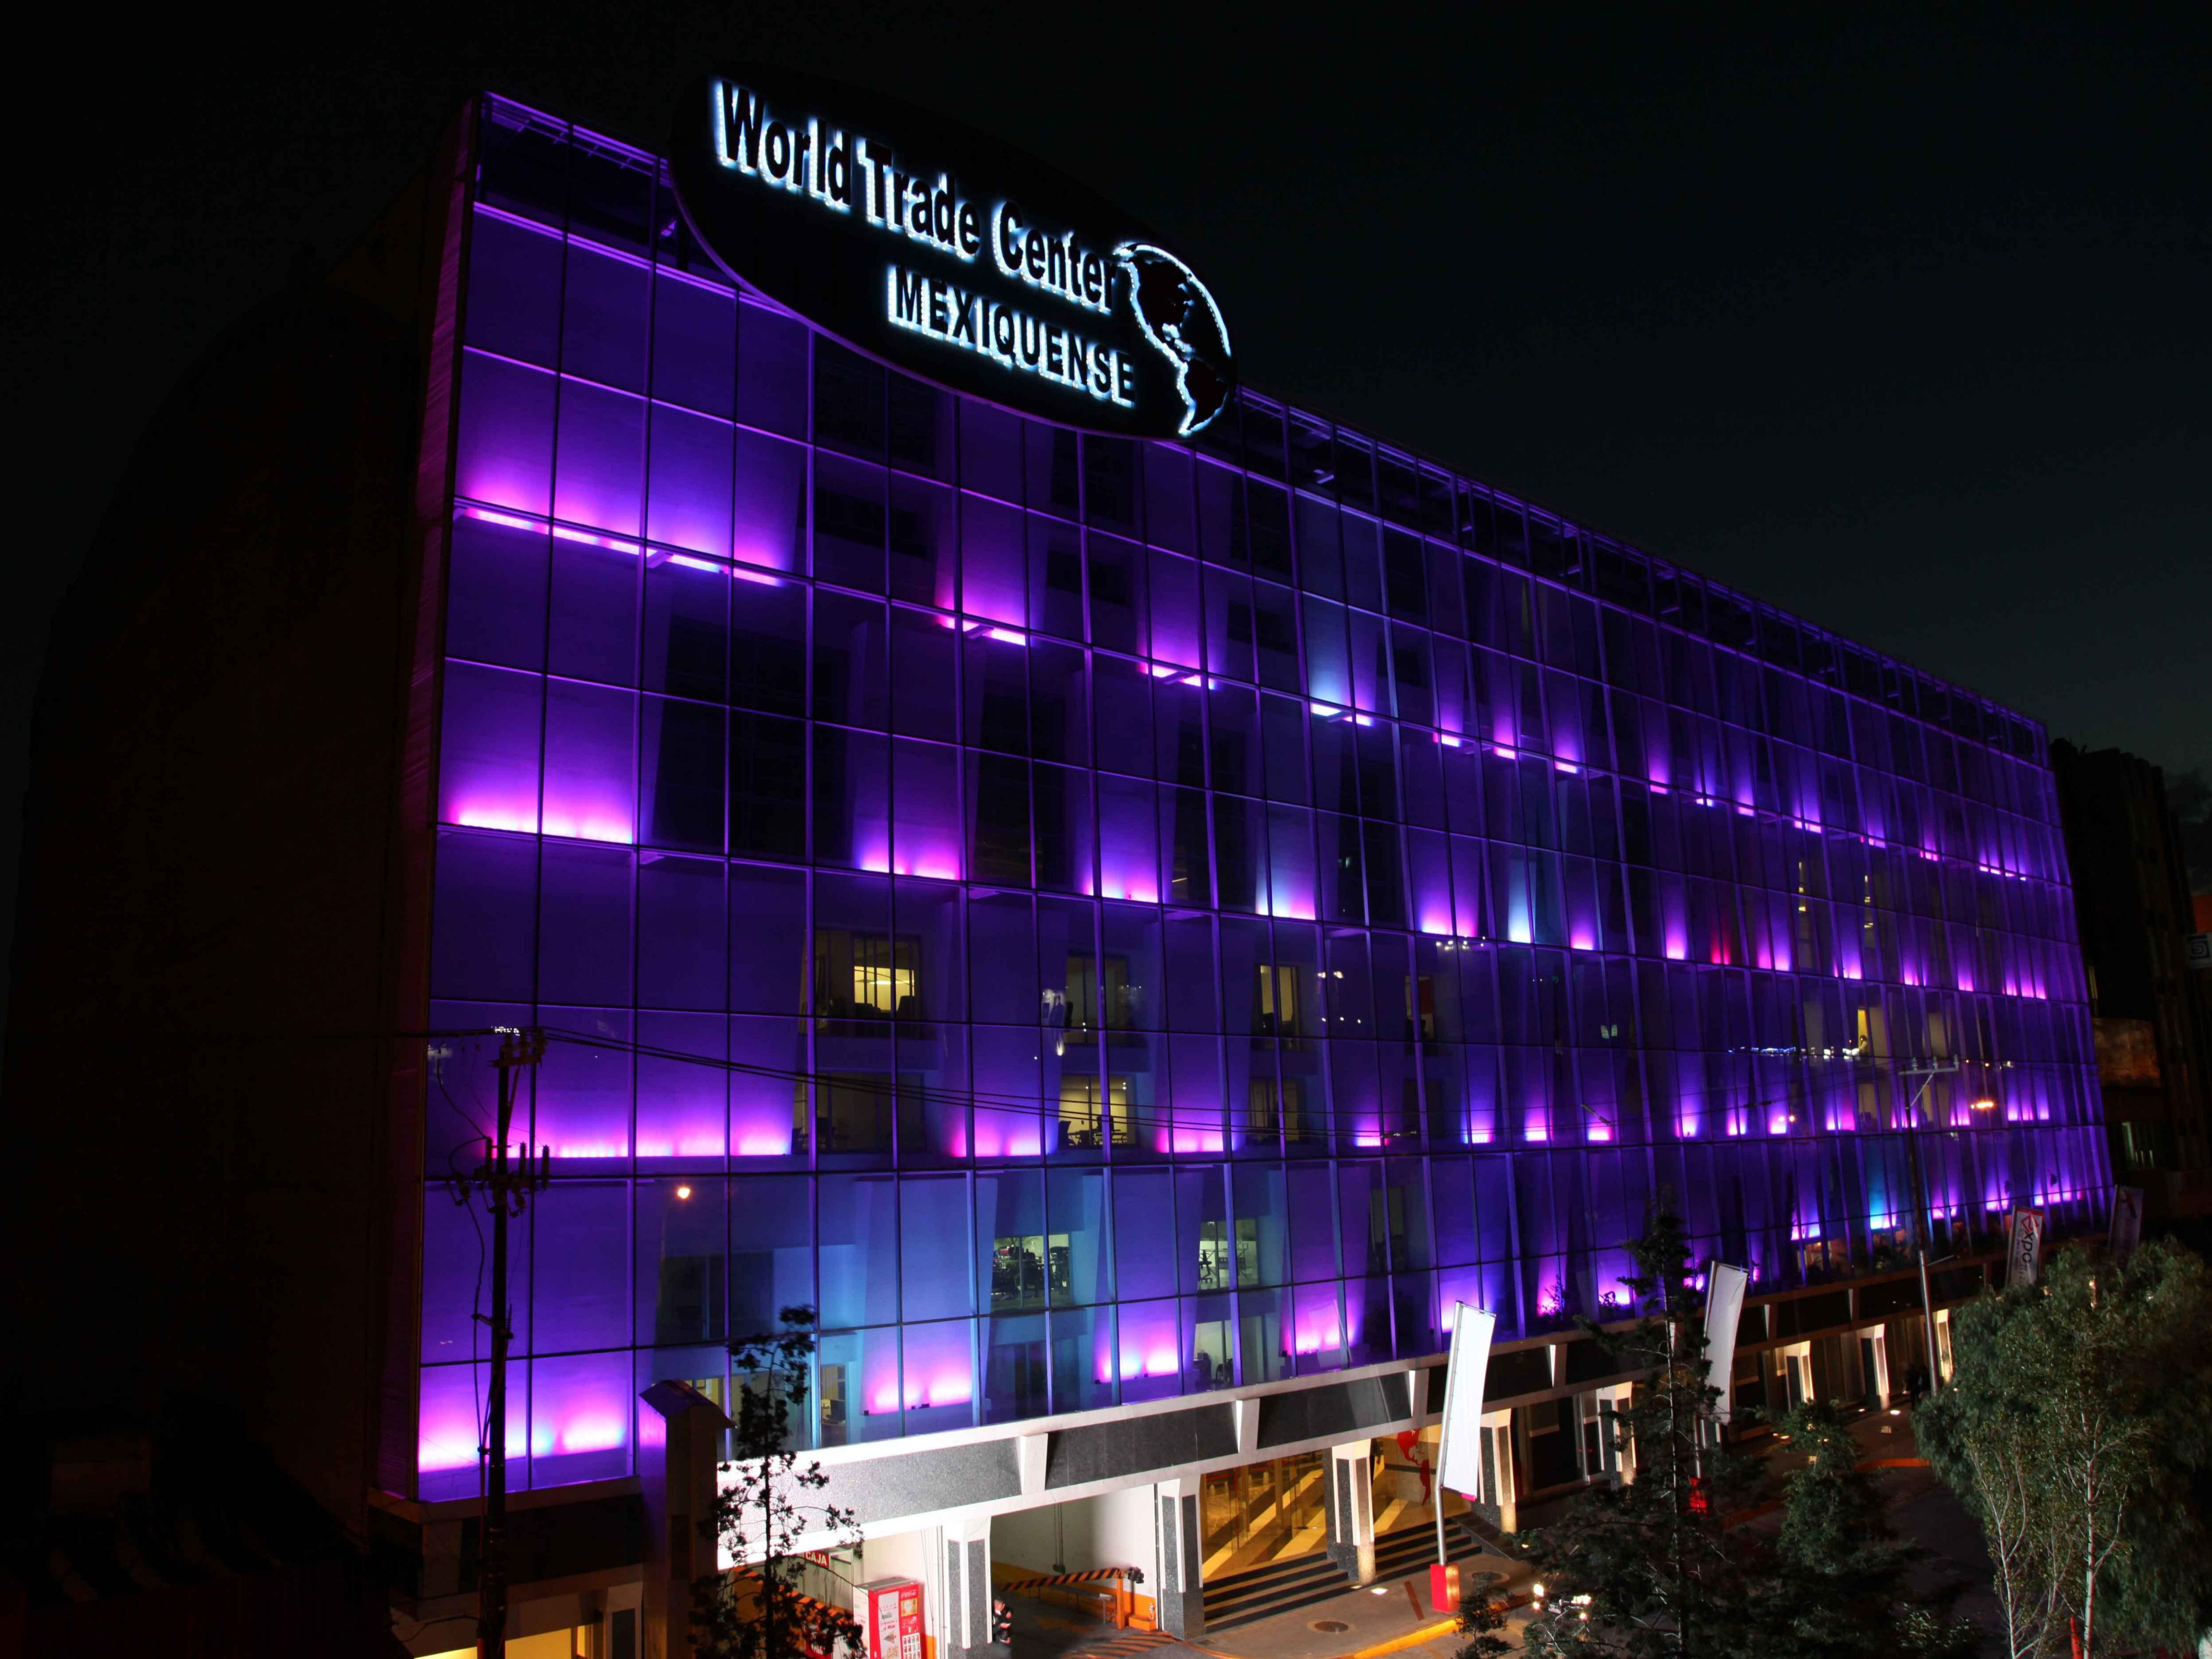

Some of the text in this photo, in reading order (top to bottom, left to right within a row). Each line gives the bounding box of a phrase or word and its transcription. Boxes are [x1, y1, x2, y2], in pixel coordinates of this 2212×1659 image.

[717, 80, 1118, 312] World Trade Center
[889, 265, 1135, 406] MEXIQUENSE
[805, 1552, 827, 1566] CAJA
